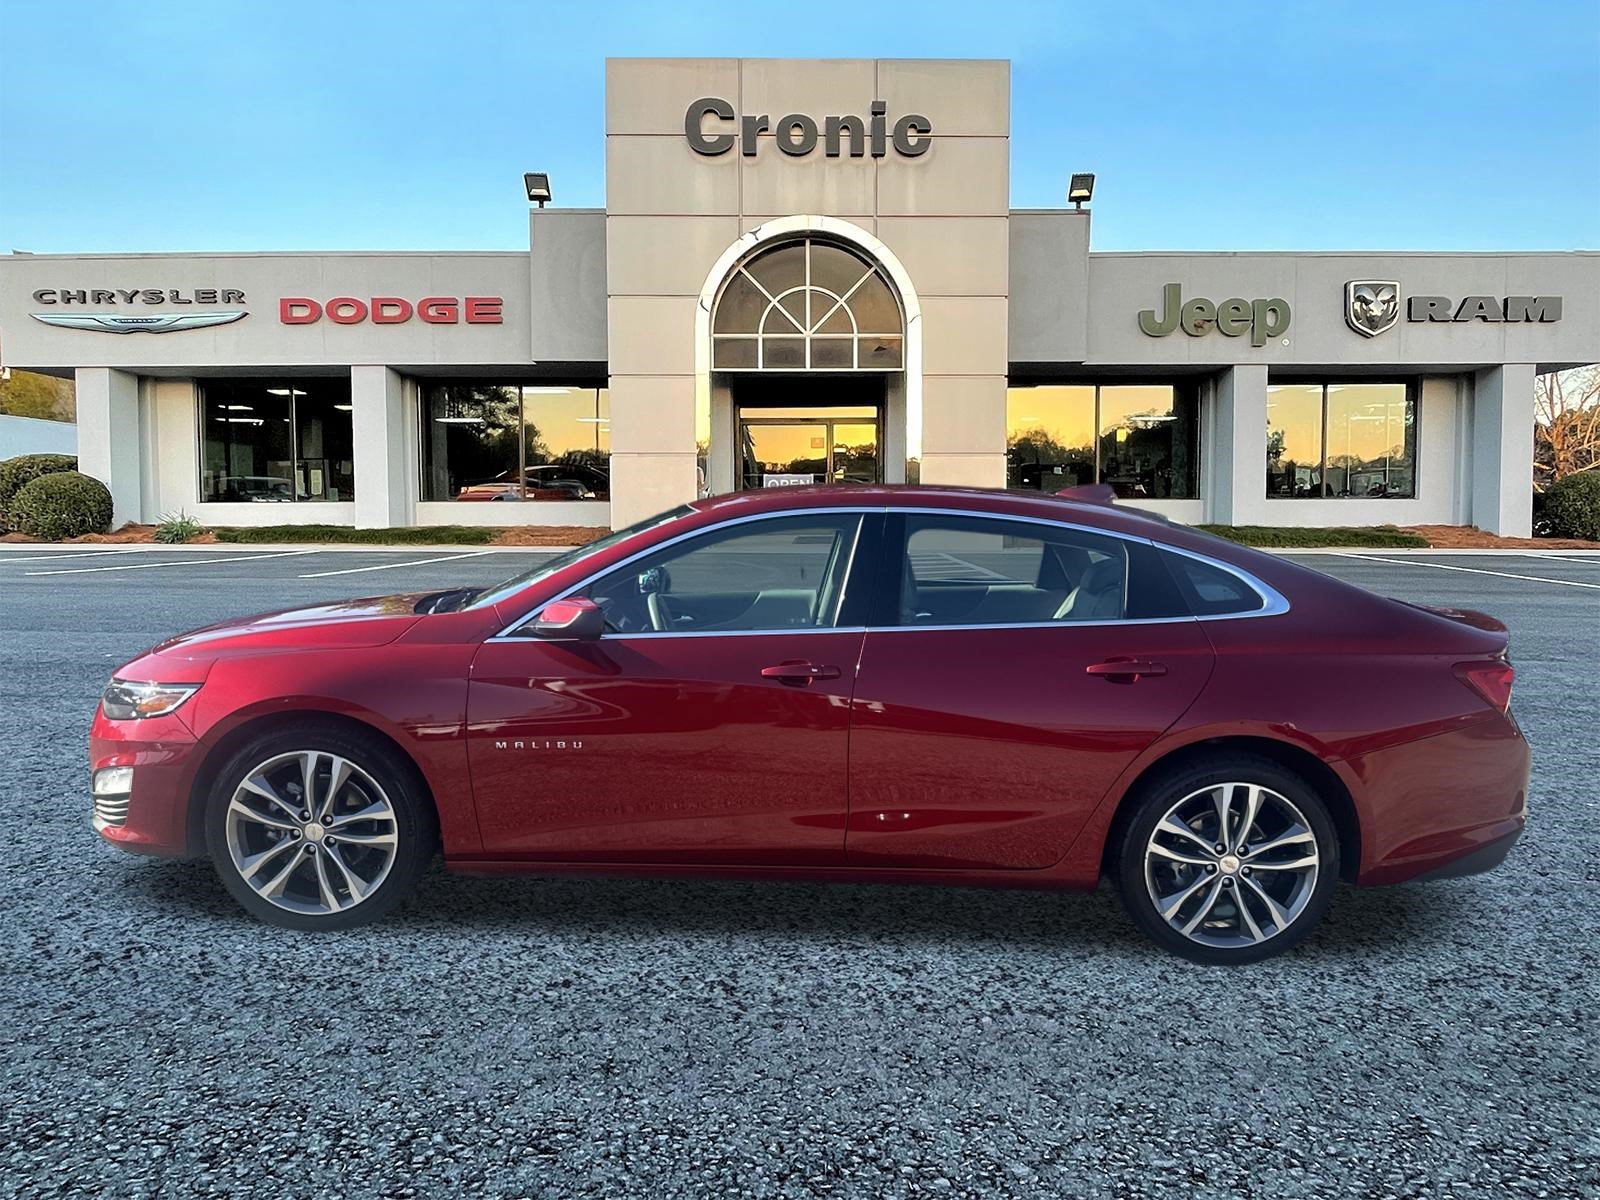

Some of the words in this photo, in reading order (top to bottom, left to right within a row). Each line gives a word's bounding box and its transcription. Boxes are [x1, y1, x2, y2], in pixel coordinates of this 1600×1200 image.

[684, 97, 933, 157] Cronic
[33, 288, 246, 305] CHRYSLER
[1407, 295, 1562, 322] RAM
[280, 297, 503, 324] DODGE
[1138, 283, 1290, 346] Jeep
[495, 741, 583, 749] MALIBU
